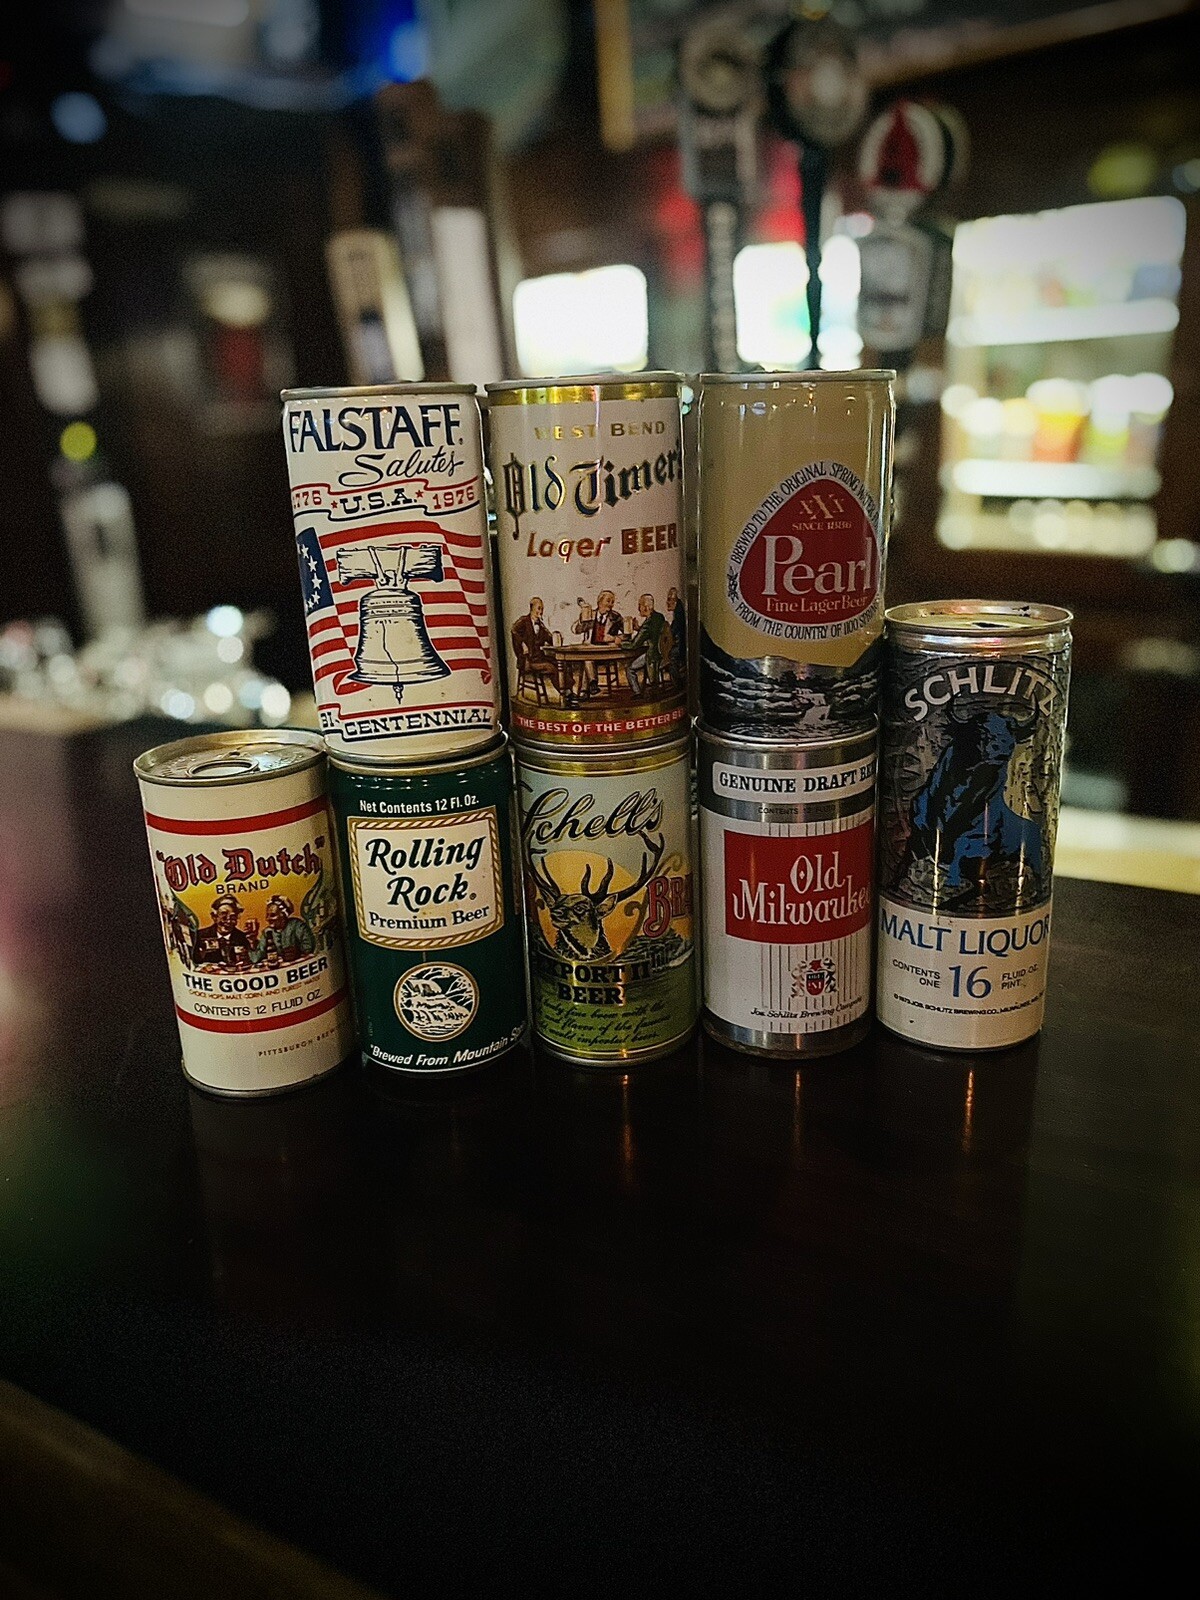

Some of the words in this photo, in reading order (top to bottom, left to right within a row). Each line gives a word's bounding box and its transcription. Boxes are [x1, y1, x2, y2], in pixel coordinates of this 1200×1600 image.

[289, 403, 460, 453] FALSTAFF
[534, 423, 597, 441] WEST
[610, 420, 666, 437] BEND
[338, 446, 465, 487] Salutes
[339, 487, 417, 515] U.S.A.
[432, 485, 476, 510] 1976
[502, 452, 566, 541] Old
[730, 522, 759, 565] BREWED
[752, 509, 767, 526] TO
[762, 490, 783, 514] THE
[780, 461, 828, 496] ORIGINAL
[829, 462, 861, 492] SPRING
[792, 522, 824, 531] SINCE
[527, 532, 612, 563] Lager
[621, 522, 678, 555] BEER
[761, 535, 873, 596] Pearl
[766, 597, 799, 612] Fine
[801, 596, 842, 615] Lager
[841, 594, 869, 610] Beer
[734, 602, 761, 628] FROM
[763, 619, 783, 638] THE
[784, 624, 830, 640] COUNTRY
[830, 623, 842, 638] OF
[904, 665, 1059, 722] SCHLITZ
[344, 708, 492, 737] CENTENNIAL
[518, 715, 536, 729] THE
[537, 720, 568, 734] BEST
[572, 723, 592, 734] OF
[595, 720, 622, 732] THE
[625, 713, 671, 730] BETTER
[719, 771, 797, 794] GENUINE
[803, 769, 858, 793] DRAFT
[359, 799, 377, 813] Net
[379, 801, 433, 815] Contents
[434, 798, 448, 812] 12
[450, 796, 463, 810] Fl.
[464, 794, 480, 806] Oz.
[521, 787, 664, 845] Schell's
[757, 806, 800, 815] CONTENTS
[365, 836, 487, 876] Rolling
[216, 878, 270, 895] BRAND
[789, 851, 846, 895] Old
[368, 910, 448, 930] Premium
[451, 905, 490, 926] Beer
[880, 907, 952, 951] MALT
[958, 912, 1050, 958] LIQUOR
[182, 972, 213, 993] THE
[218, 974, 280, 994] GOOD
[286, 956, 329, 985] BEER
[892, 958, 941, 980] CONTENTS
[919, 976, 941, 989] ONE
[948, 964, 993, 999] 16
[1001, 968, 1027, 983] FLUID
[192, 1001, 251, 1017] CONTENTS
[254, 1004, 268, 1015] 12
[270, 996, 304, 1013] FLUID
[305, 988, 323, 1002] OZ
[557, 982, 626, 1006] BEER
[766, 1010, 799, 1019] Schlitz
[799, 1007, 836, 1019] Brewing
[924, 1004, 953, 1014] SCHLITZ
[258, 1038, 313, 1058] PITTSBURGH
[415, 1053, 450, 1067] From
[452, 1036, 508, 1064] Mountain
